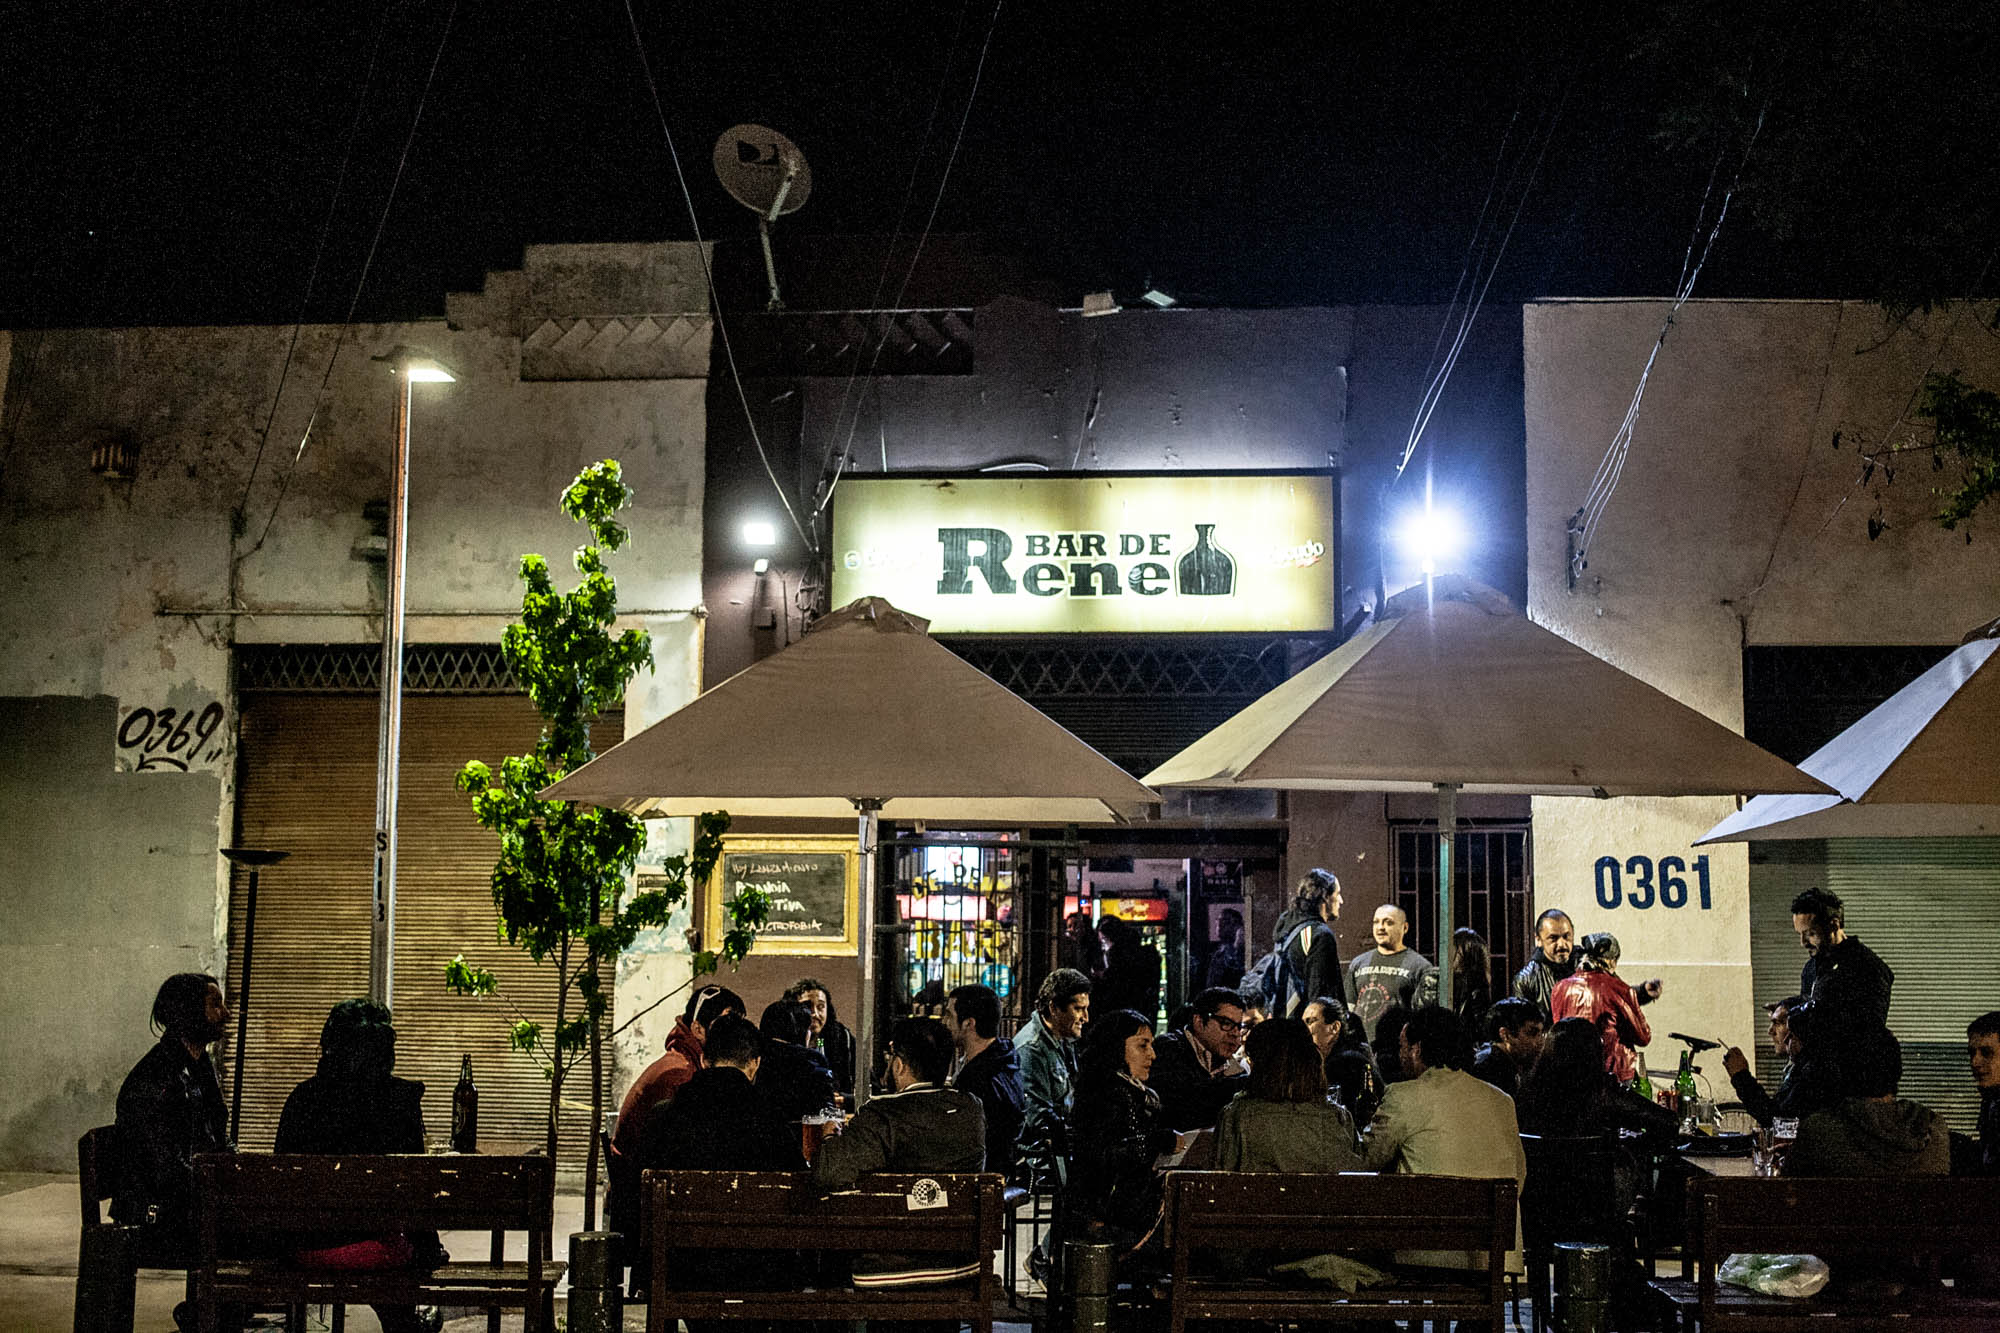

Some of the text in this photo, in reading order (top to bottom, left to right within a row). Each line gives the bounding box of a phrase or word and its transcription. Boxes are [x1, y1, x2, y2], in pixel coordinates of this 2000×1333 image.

[937, 527, 1171, 597] Rene
[1025, 533, 1171, 557] BAR DE
[118, 701, 224, 761] 0369
[1594, 854, 1712, 910] 0361
